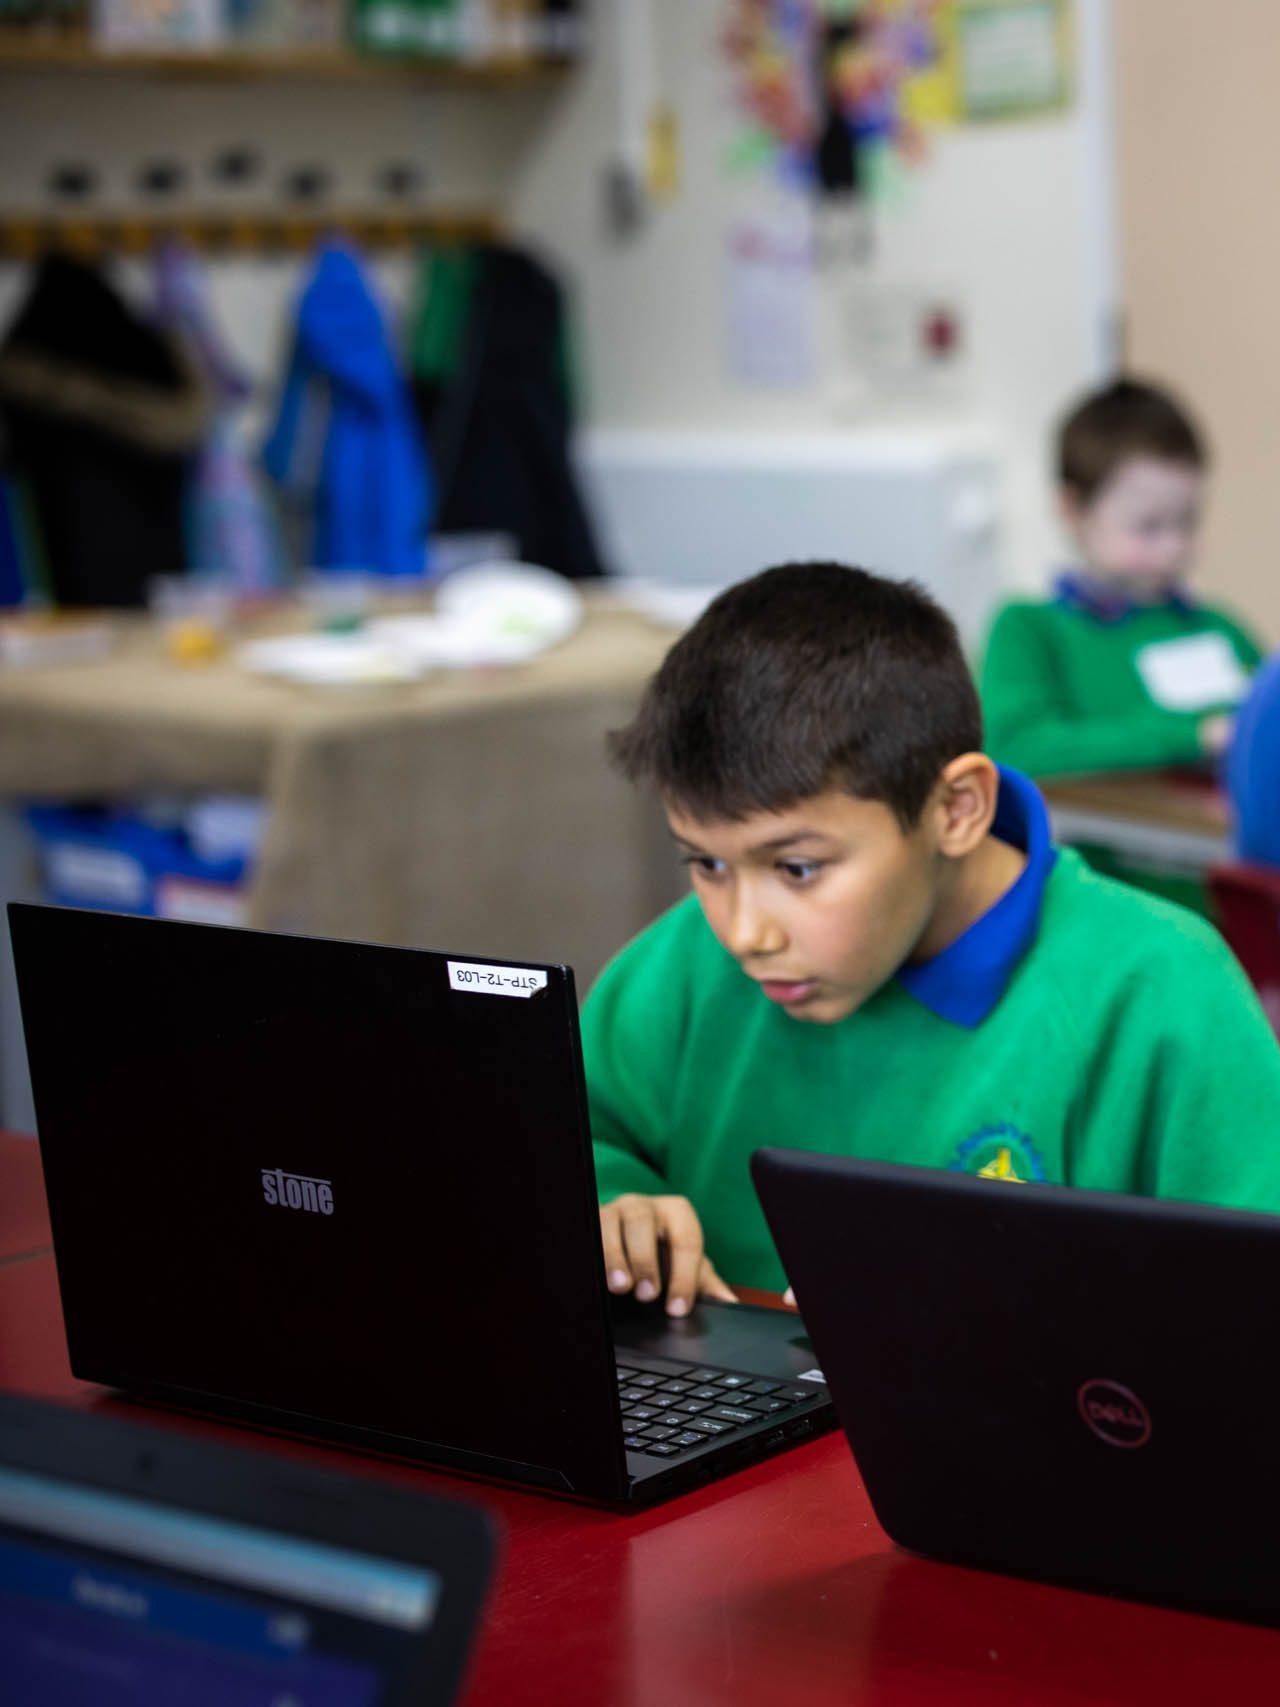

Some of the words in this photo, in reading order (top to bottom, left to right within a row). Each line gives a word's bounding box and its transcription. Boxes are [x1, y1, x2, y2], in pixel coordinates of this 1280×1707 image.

[456, 969, 538, 989] STP-T2-L03
[261, 1167, 334, 1216] stone
[1086, 1400, 1145, 1427] DELL
